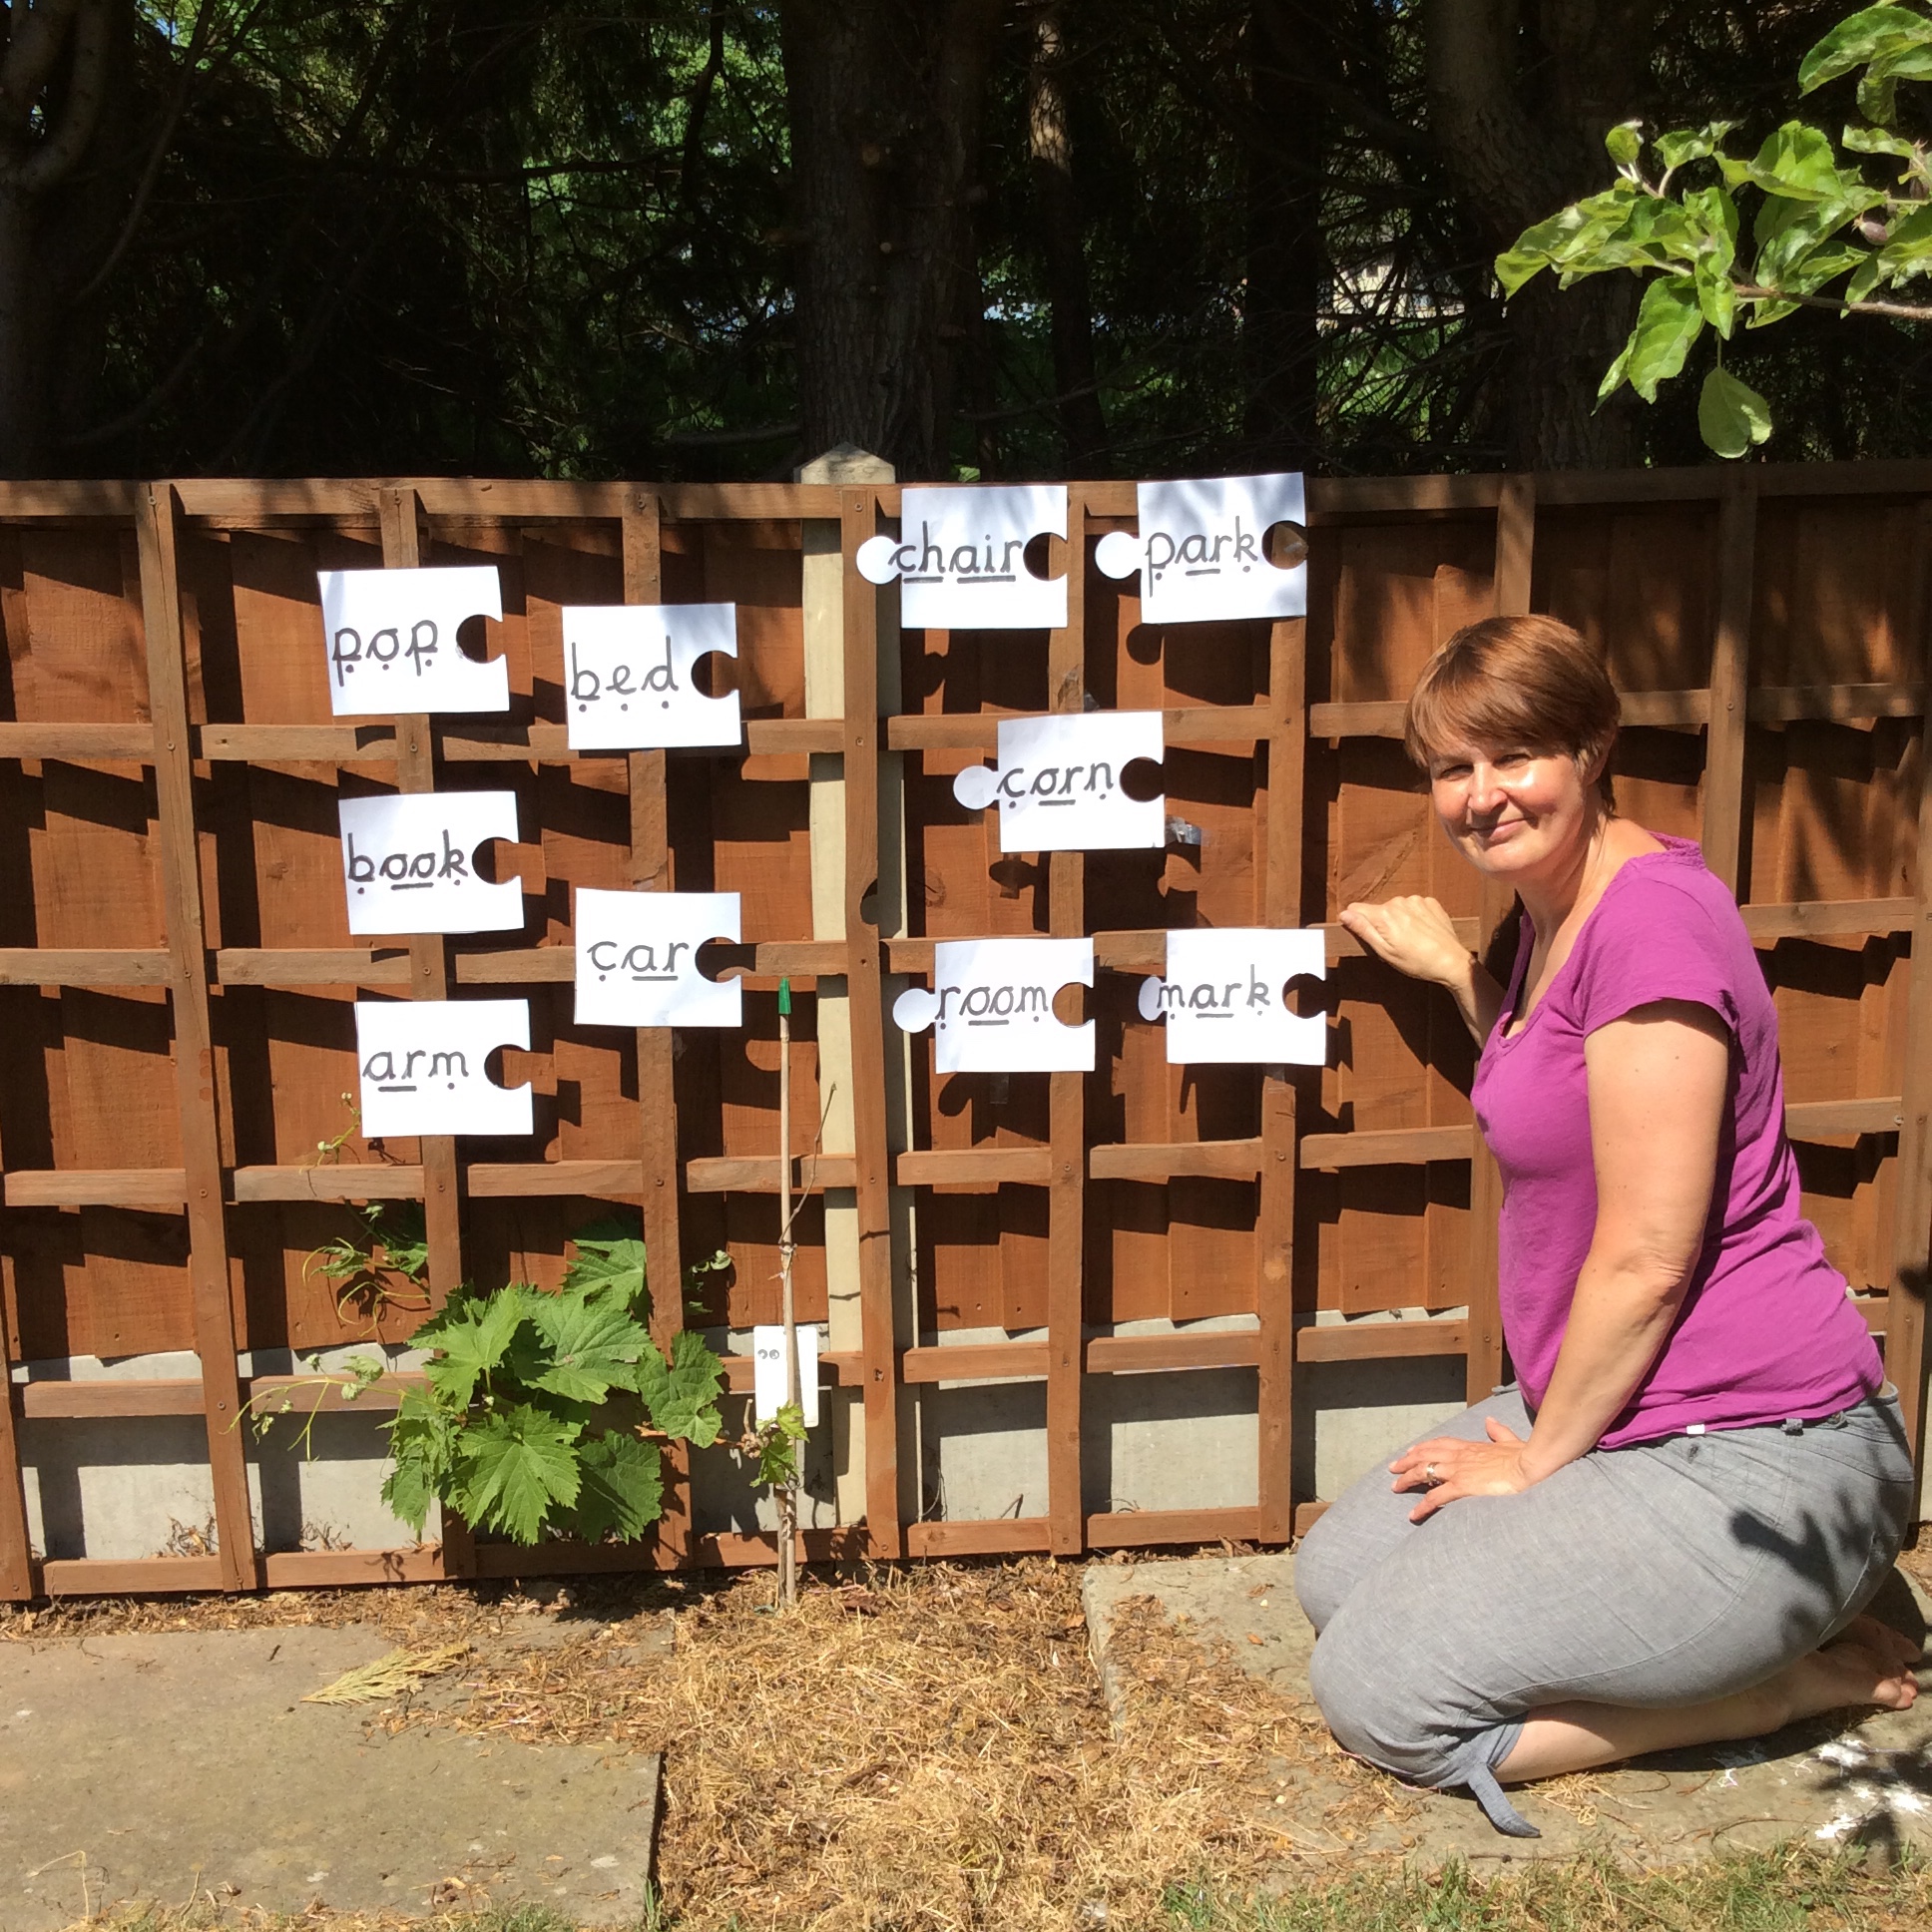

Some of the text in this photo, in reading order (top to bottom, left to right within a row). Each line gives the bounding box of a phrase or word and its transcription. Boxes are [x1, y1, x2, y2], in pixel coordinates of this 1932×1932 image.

[888, 520, 1024, 573] chair
[1145, 515, 1258, 598] park
[332, 620, 438, 687] pop
[571, 635, 679, 702] bed
[996, 761, 1114, 797] corn
[347, 829, 468, 882] book
[587, 940, 690, 973] car
[935, 984, 1049, 1021] room
[1157, 963, 1270, 1010] mark
[362, 1050, 469, 1081] arm
